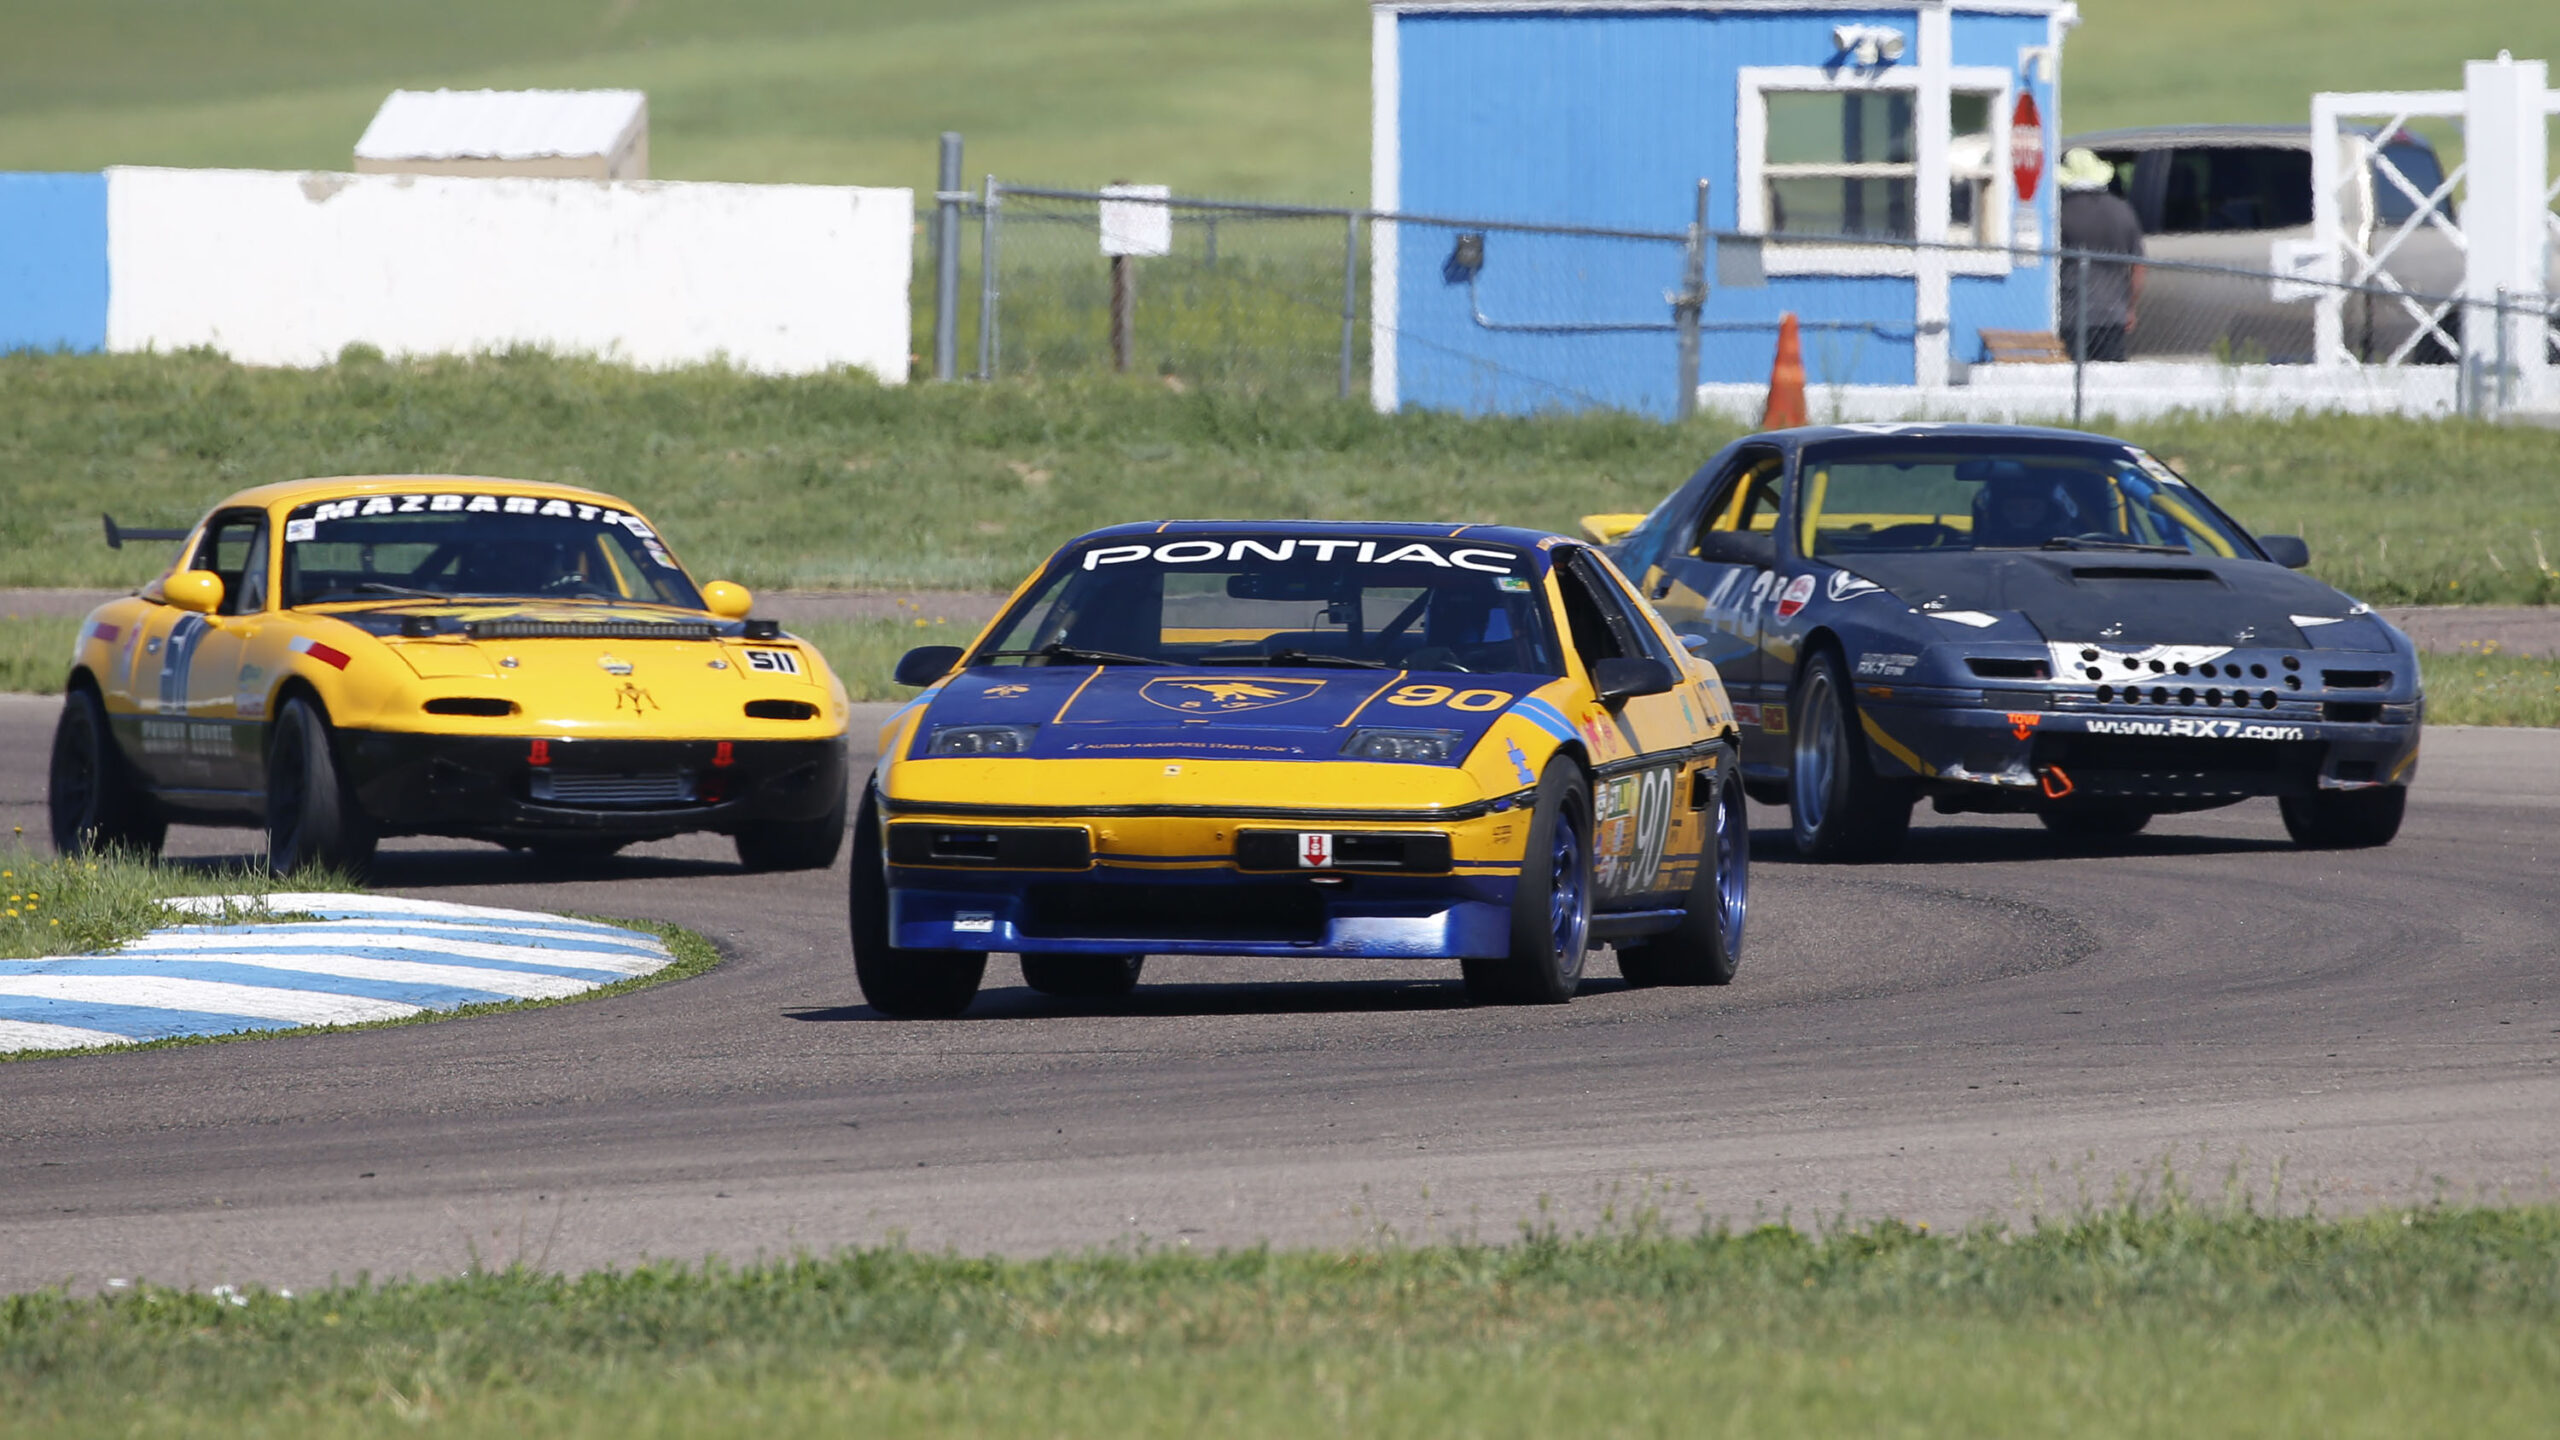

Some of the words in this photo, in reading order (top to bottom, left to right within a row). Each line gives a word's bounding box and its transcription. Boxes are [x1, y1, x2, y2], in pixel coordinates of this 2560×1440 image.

[1083, 540, 1517, 574] PONTIAC
[747, 651, 796, 673] 511
[1387, 685, 1514, 712] 90
[2007, 713, 2041, 726] TOW
[2086, 718, 2304, 741] www.RX7.com
[1209, 742, 1251, 750] STARTS
[1627, 768, 1671, 889] 90
